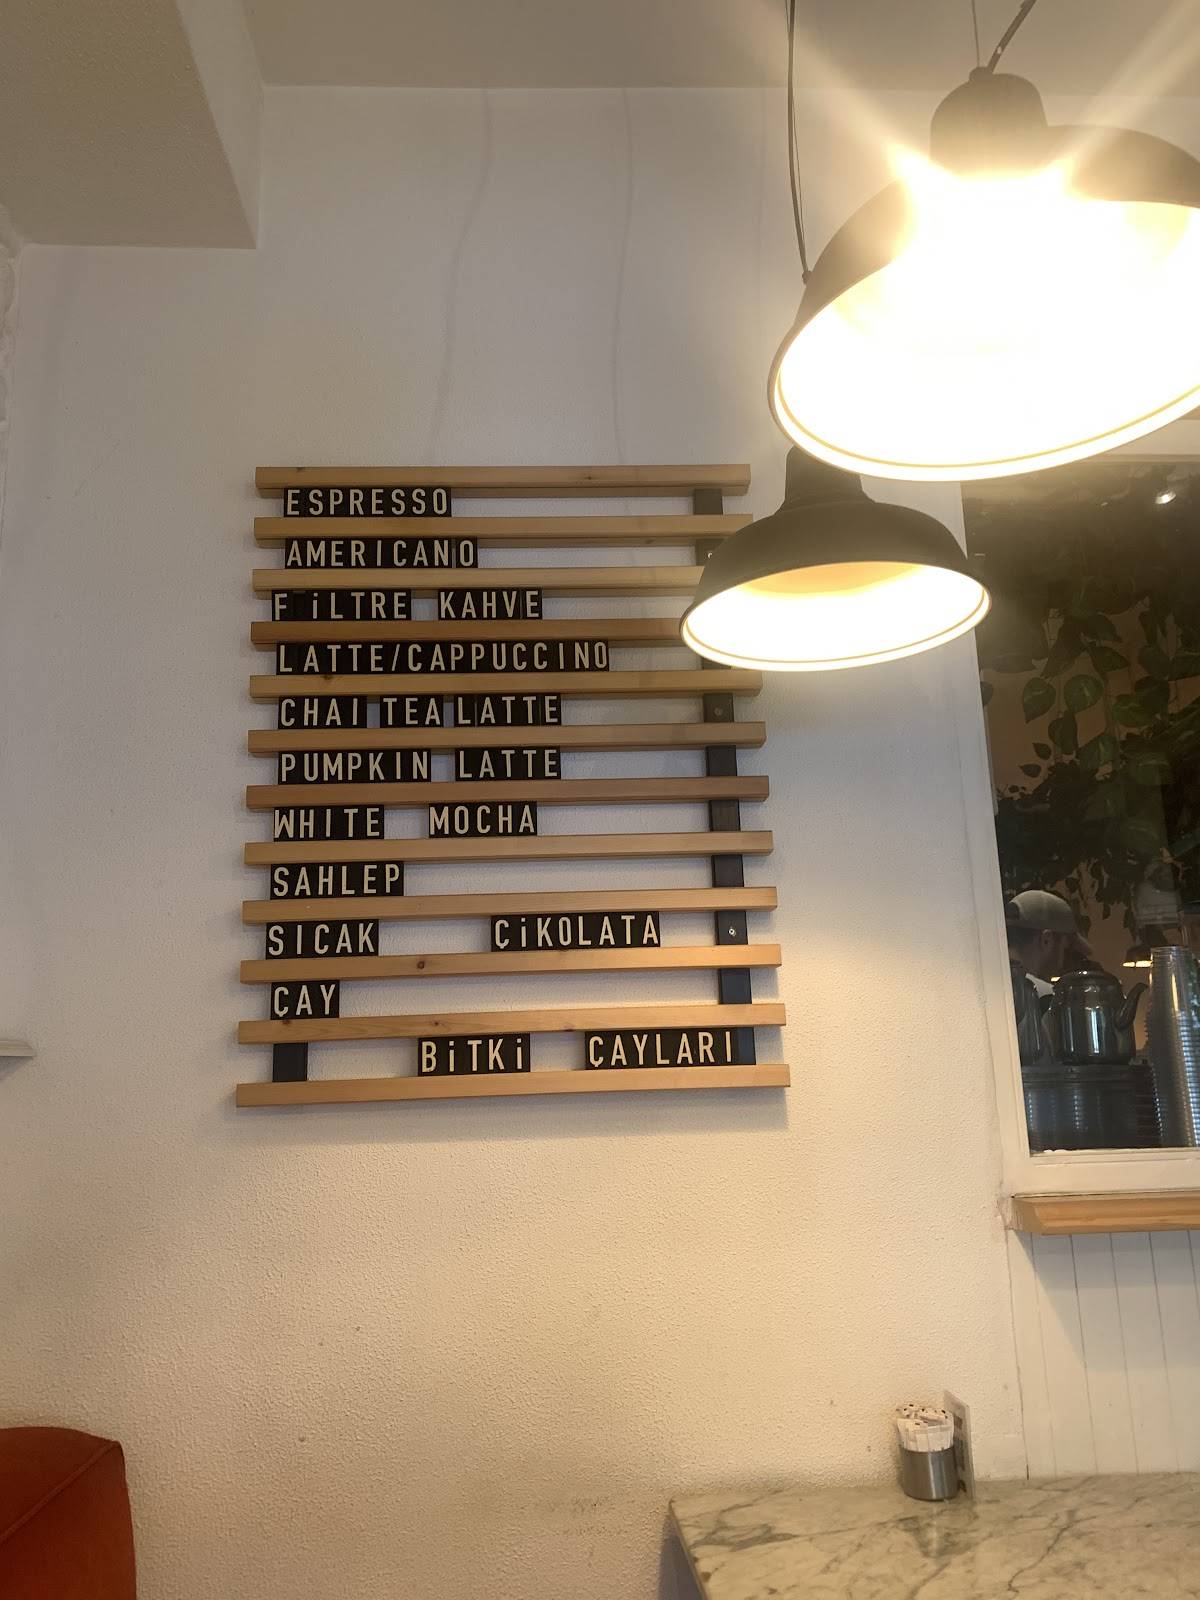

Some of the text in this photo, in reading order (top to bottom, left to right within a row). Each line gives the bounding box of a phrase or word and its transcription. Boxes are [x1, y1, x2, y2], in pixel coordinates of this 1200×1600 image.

[286, 488, 449, 516] ESPRESSO
[286, 539, 475, 568] AMERICANO
[439, 589, 540, 619] KAHVE
[280, 695, 559, 727] CHAI TEA LATTE
[280, 749, 559, 782] PUMPKIN LATTE
[274, 803, 535, 840] WHITE MOCHA
[273, 864, 401, 897] SAHLEP
[268, 922, 377, 956] SICAK
